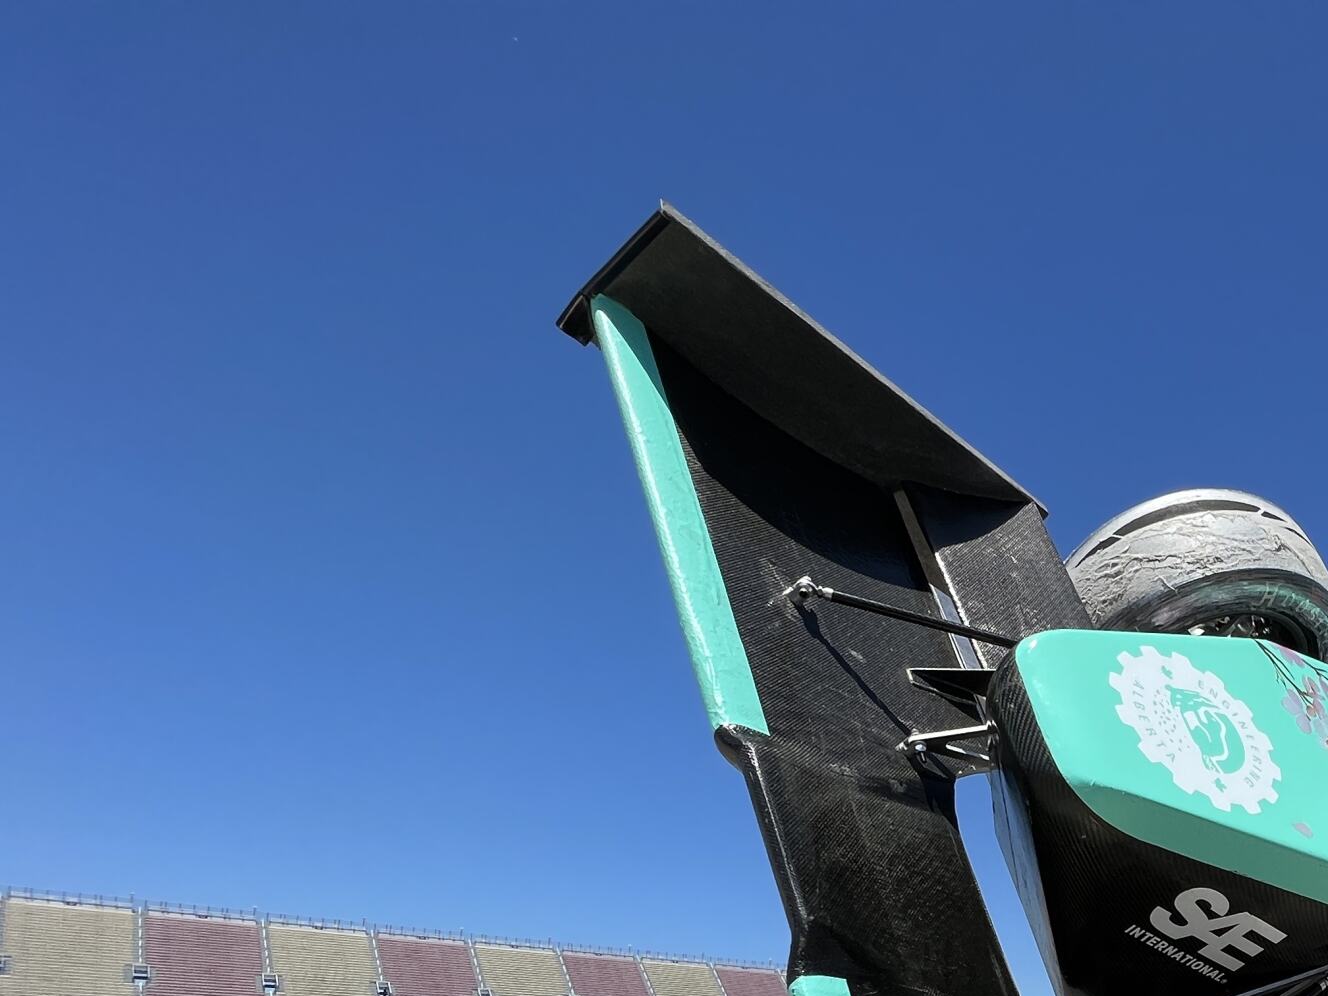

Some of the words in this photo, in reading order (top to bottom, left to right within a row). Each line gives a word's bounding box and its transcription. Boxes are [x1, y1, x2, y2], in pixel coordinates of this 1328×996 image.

[1132, 679, 1177, 763] ALBERTA
[1197, 678, 1263, 789] ENGINEERING
[1124, 924, 1224, 983] INTERNATIONAL
[1149, 887, 1289, 972] SAE
